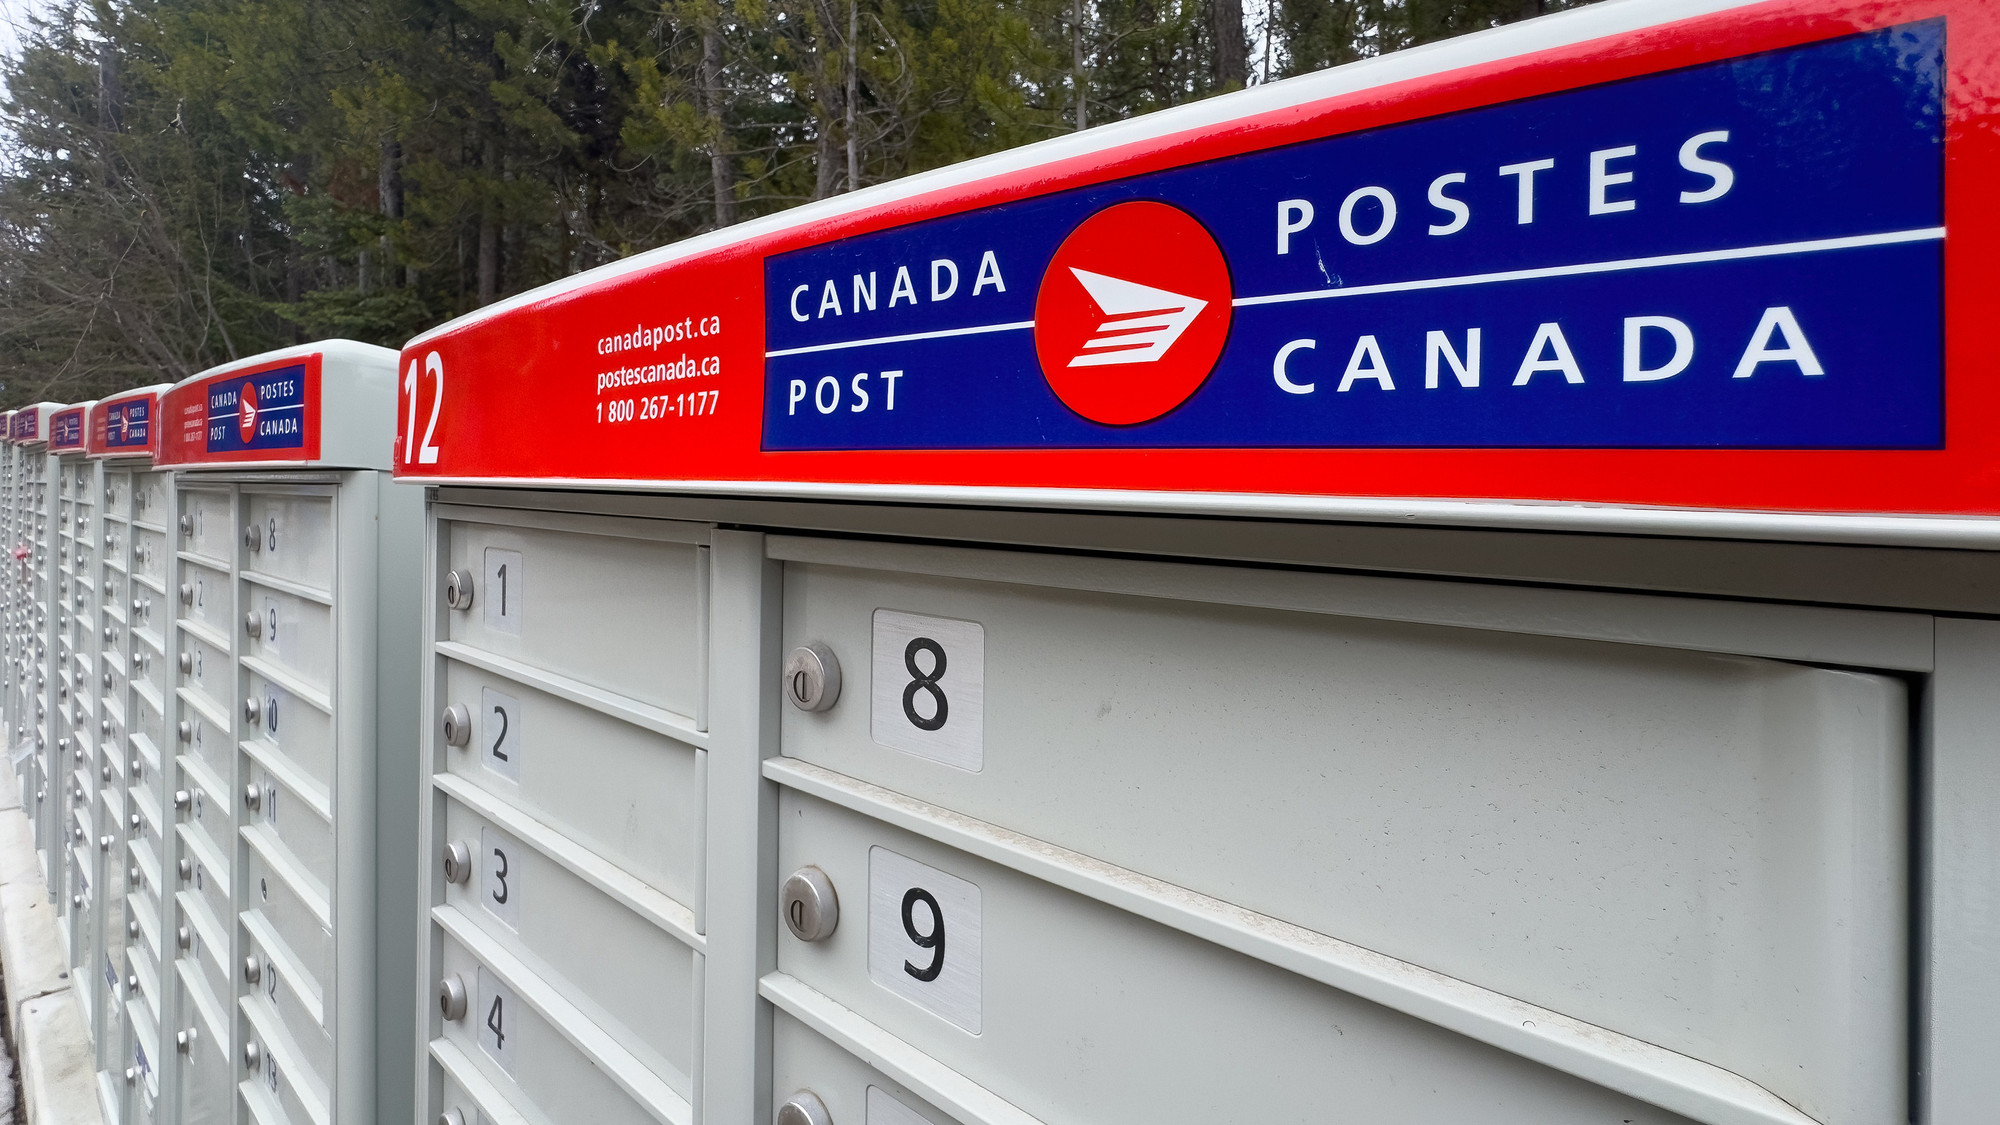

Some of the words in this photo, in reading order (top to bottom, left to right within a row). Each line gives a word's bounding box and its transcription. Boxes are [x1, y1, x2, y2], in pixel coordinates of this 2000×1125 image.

[1277, 130, 1736, 254] POSTES
[789, 250, 1006, 322] CANADA
[597, 316, 721, 355] canadapost.ca
[1273, 306, 1826, 395] CANADA
[260, 380, 294, 400] POSTES
[596, 352, 721, 396] postescanada.ca
[788, 370, 904, 416] POST
[211, 391, 238, 408] CANADA
[403, 349, 445, 465] 12
[595, 403, 603, 424] 1
[608, 398, 635, 423] 800
[639, 390, 720, 422] 267-1177
[210, 426, 226, 441] POST
[260, 418, 298, 436] CANADA
[269, 518, 276, 552] 8
[198, 580, 203, 607] 2
[496, 563, 508, 616] 1
[270, 607, 277, 642] 9
[197, 650, 202, 677] 3
[902, 637, 949, 731] 8
[267, 697, 278, 733] 10
[492, 705, 509, 762] 2
[268, 787, 277, 824] 11
[196, 864, 202, 890] 6
[492, 847, 509, 905] 3
[901, 886, 946, 982] 9
[267, 962, 277, 1005] 12
[487, 994, 505, 1050] 4
[266, 1051, 278, 1094] 13
